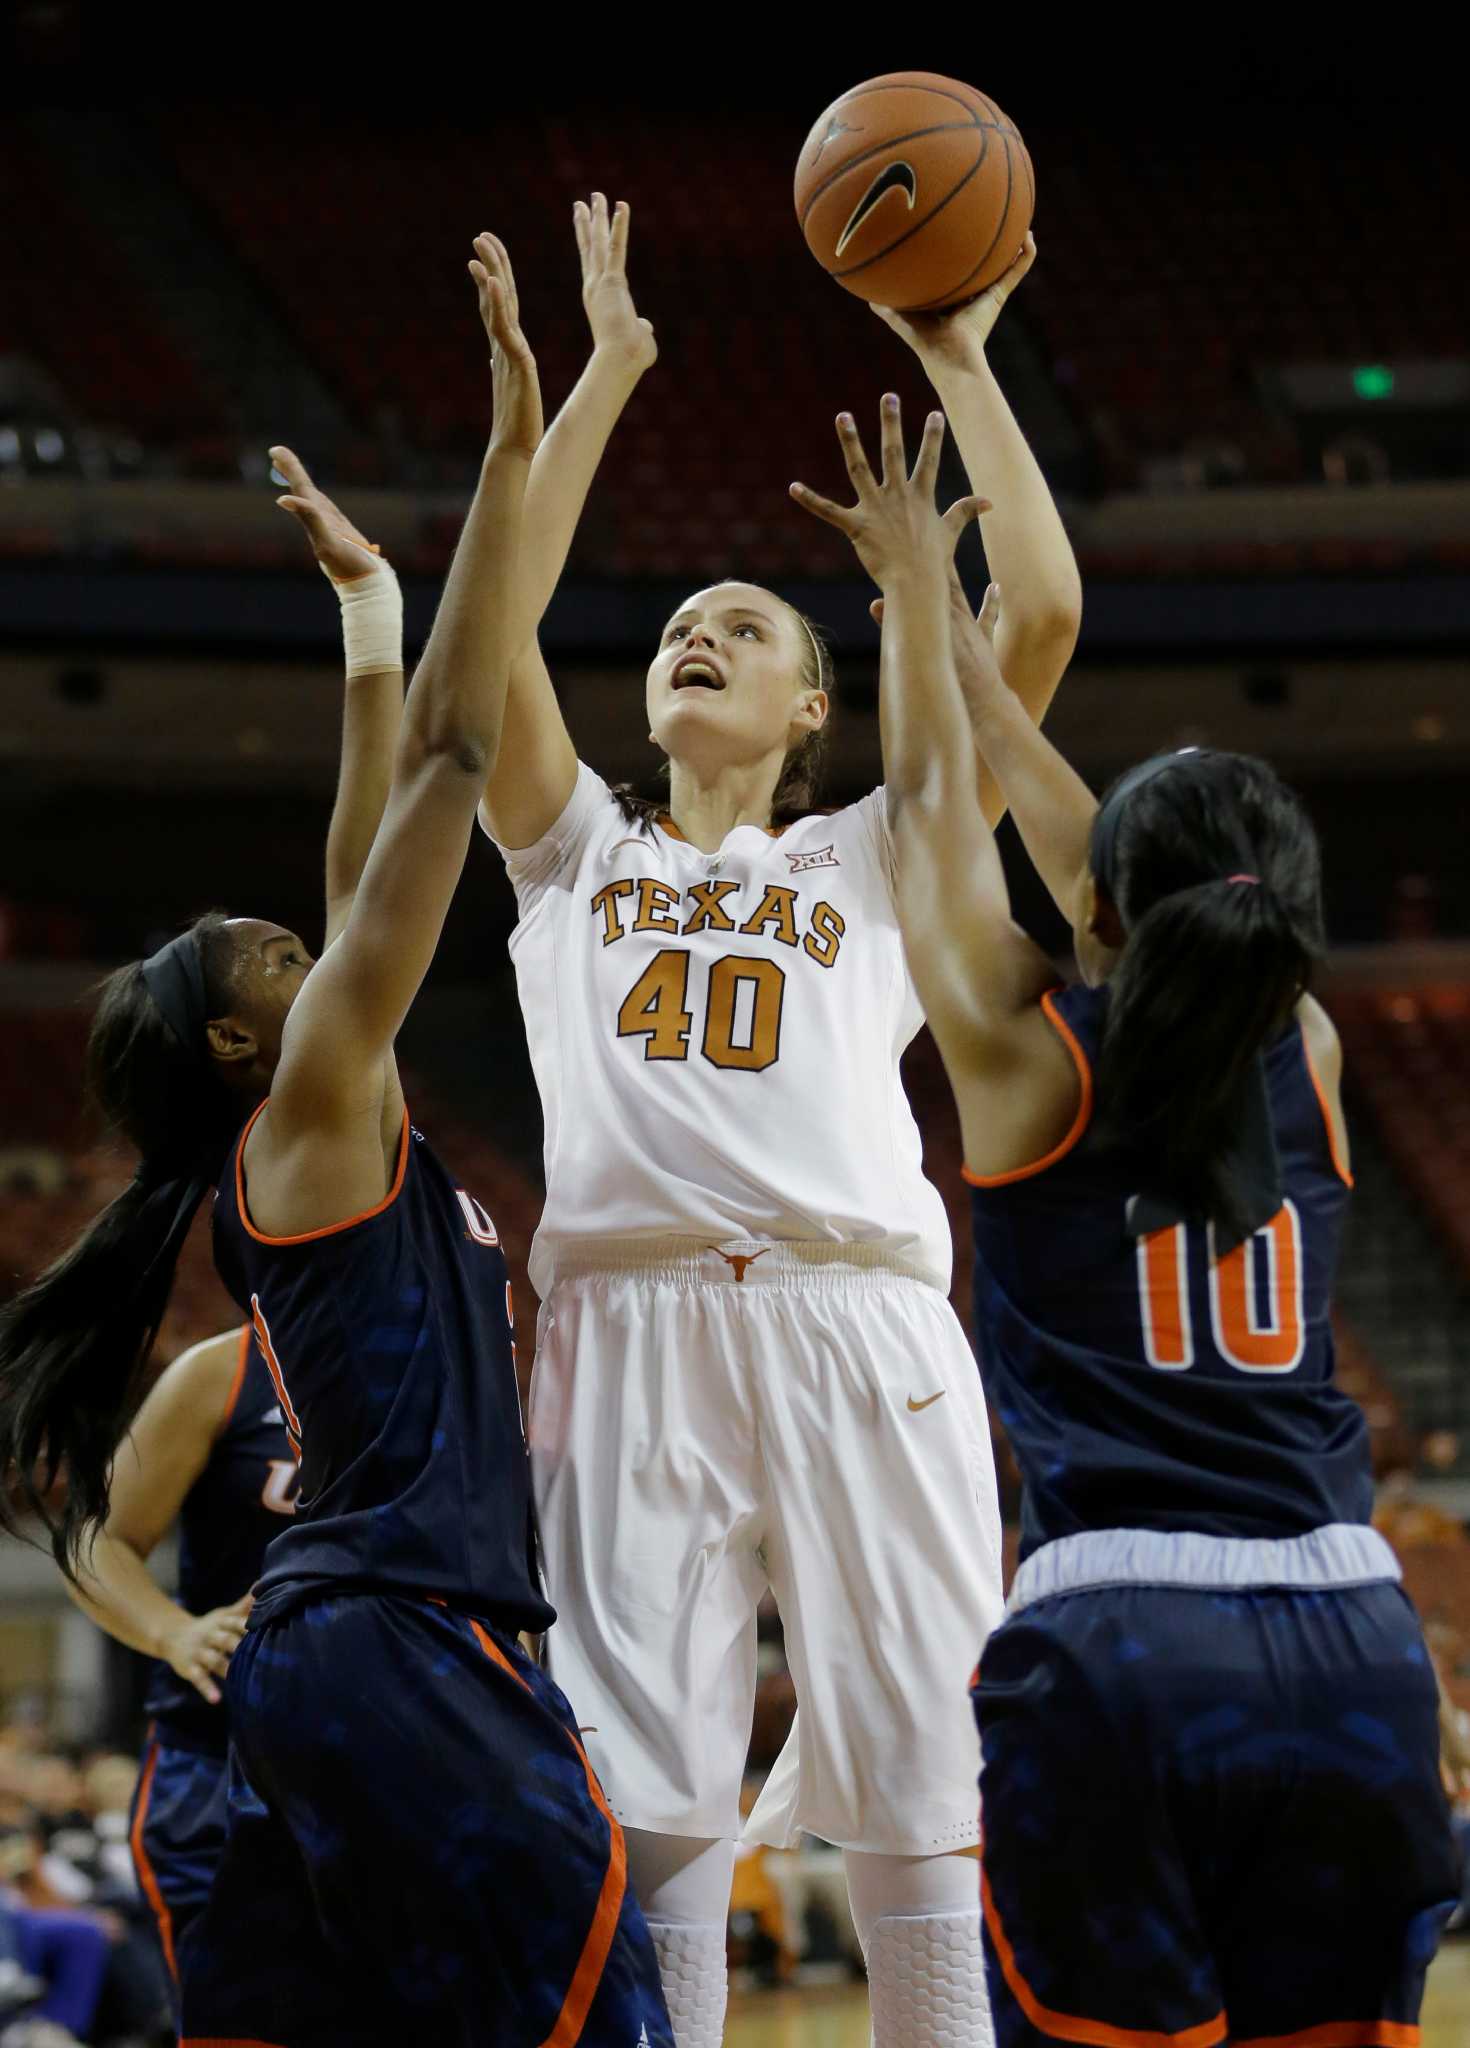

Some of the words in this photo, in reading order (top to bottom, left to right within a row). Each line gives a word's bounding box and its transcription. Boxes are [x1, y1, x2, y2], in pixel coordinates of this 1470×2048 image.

[591, 878, 846, 968] TEXAS
[616, 949, 786, 1073] 40
[1125, 1195, 1306, 1374] 10
